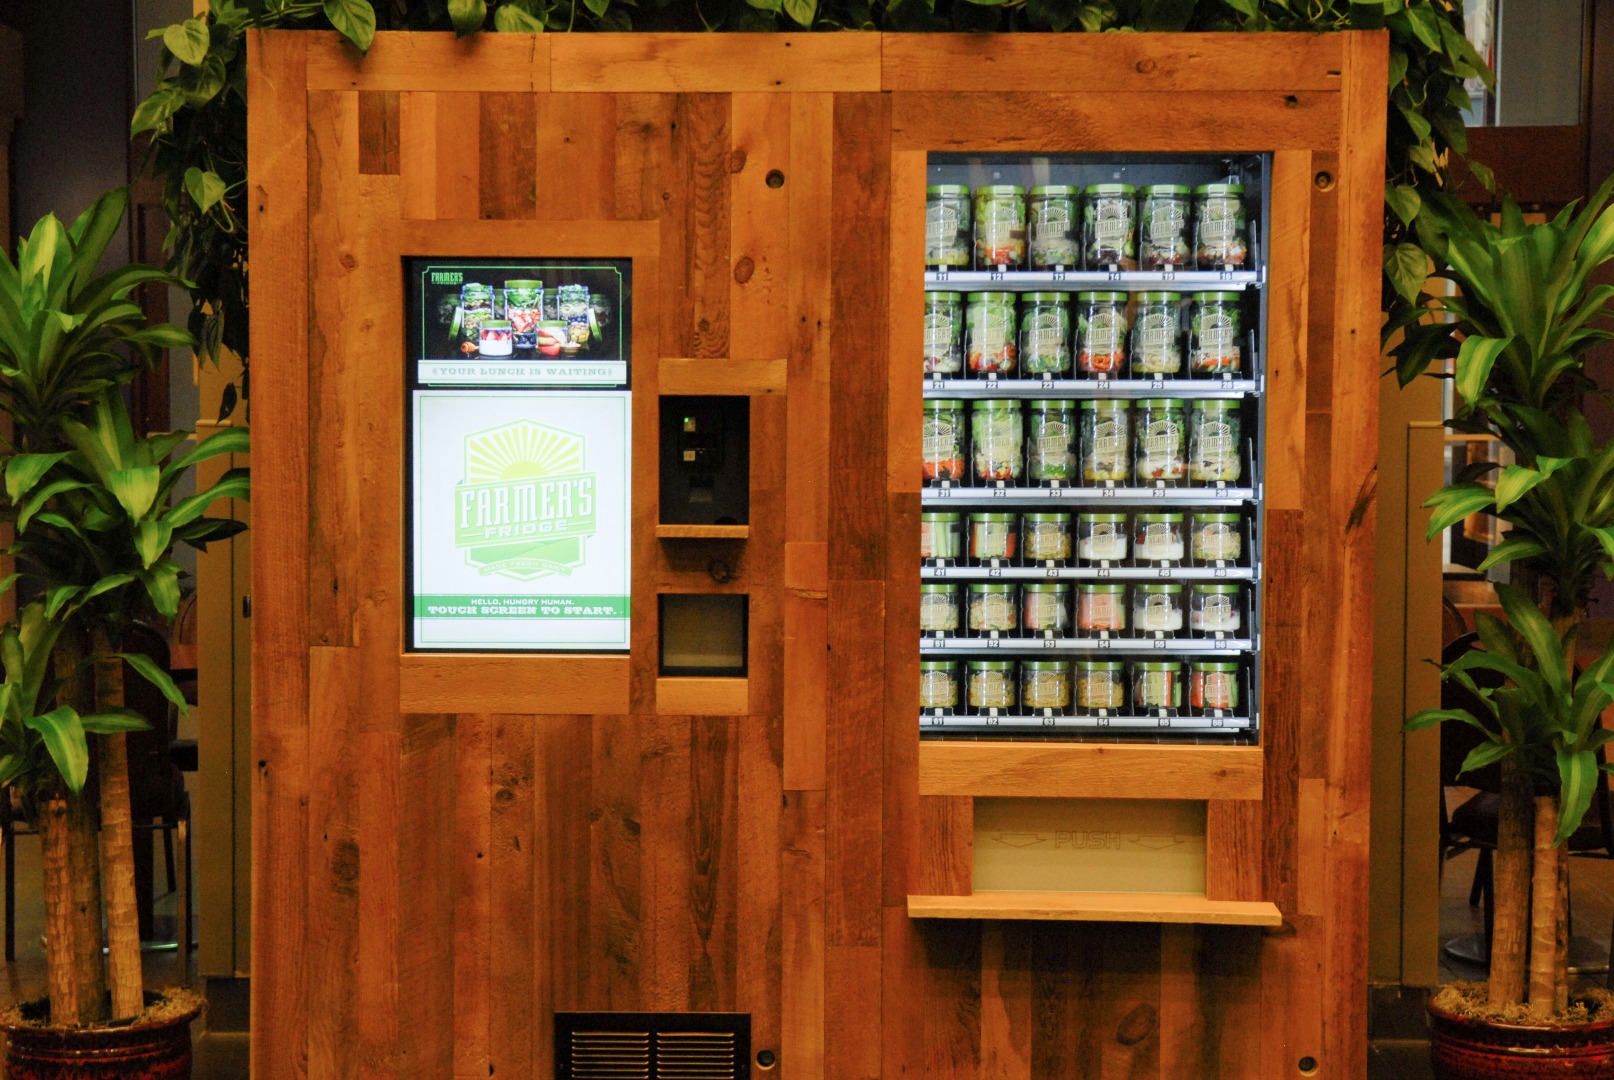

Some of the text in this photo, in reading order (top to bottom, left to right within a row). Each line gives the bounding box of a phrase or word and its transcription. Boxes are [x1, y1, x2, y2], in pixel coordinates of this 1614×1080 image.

[439, 368, 606, 376] YOUR LUNCH IS WAITING
[460, 477, 593, 529] FARMER'S
[484, 519, 568, 539] FRIDGE
[484, 563, 507, 572] MADE
[542, 562, 566, 573] DAILY
[428, 606, 617, 615] TOUCH SCREEN TO START.
[1054, 830, 1121, 849] PUSH
